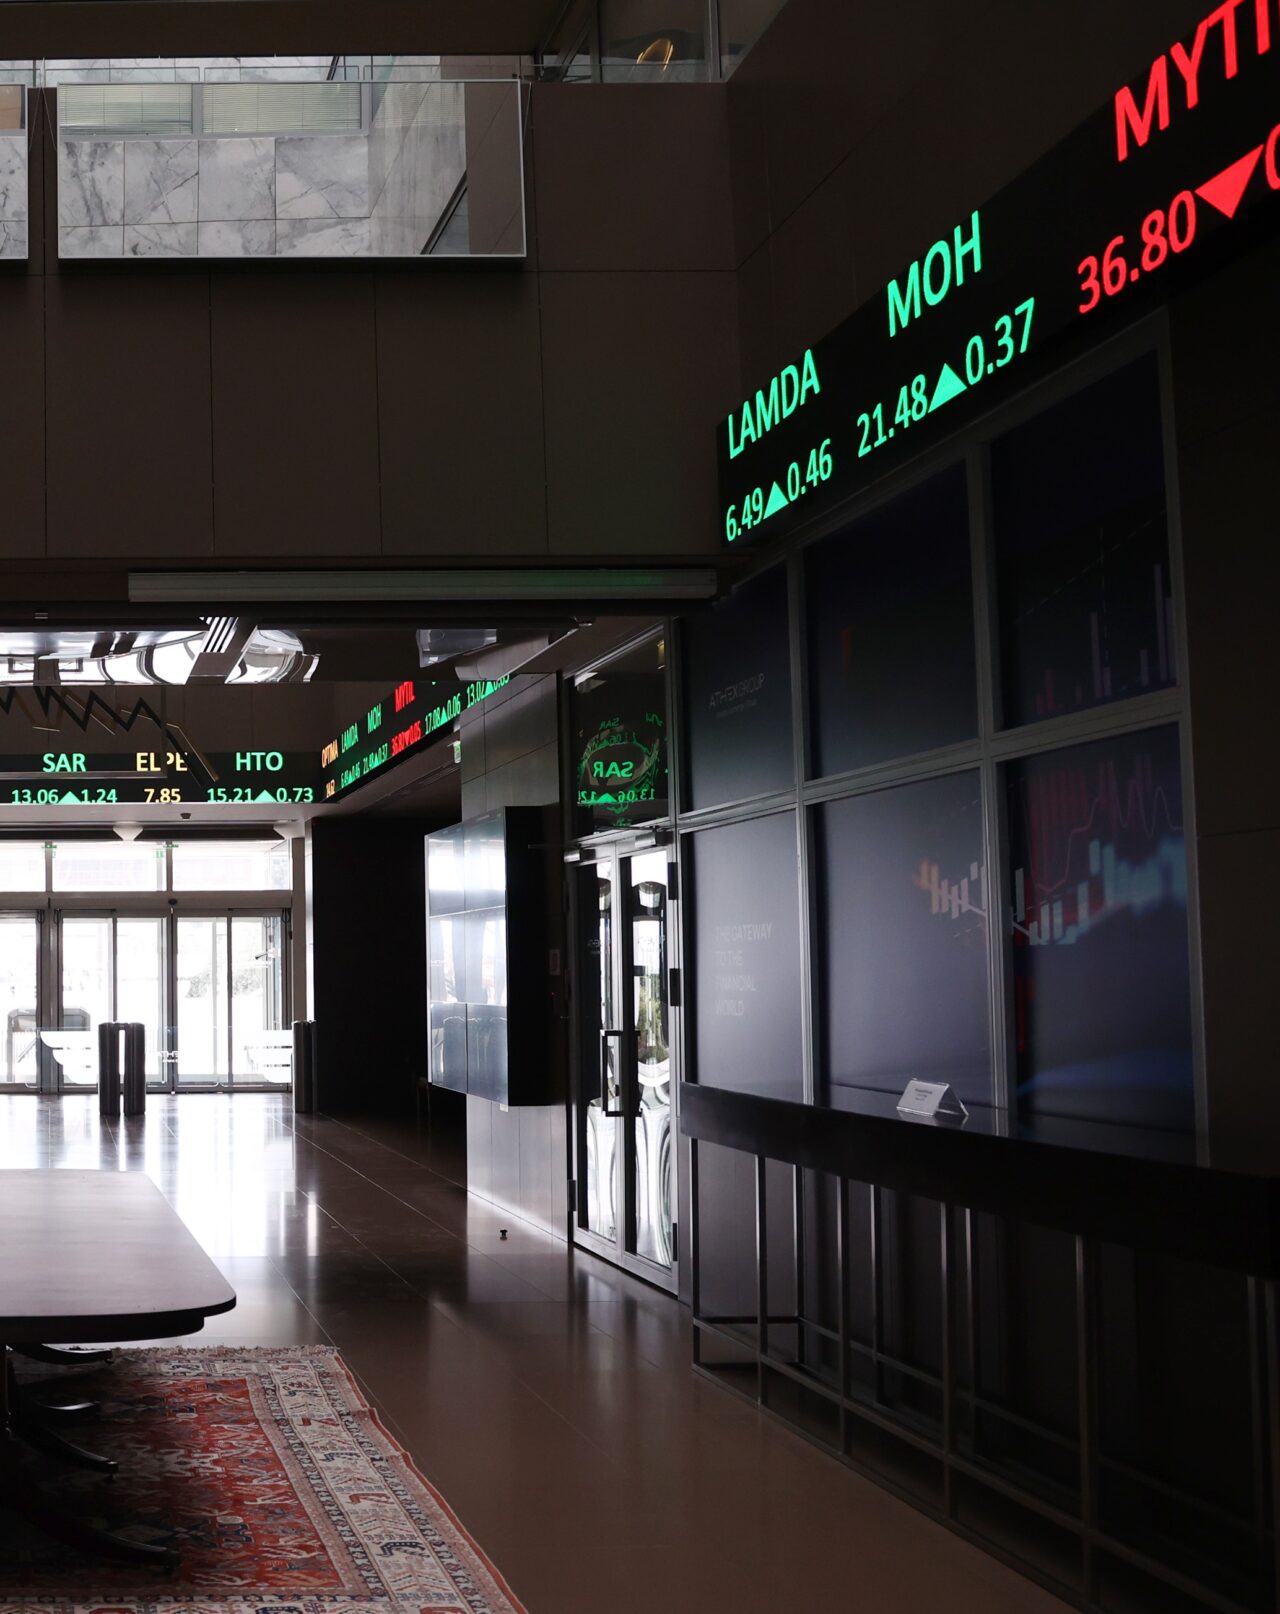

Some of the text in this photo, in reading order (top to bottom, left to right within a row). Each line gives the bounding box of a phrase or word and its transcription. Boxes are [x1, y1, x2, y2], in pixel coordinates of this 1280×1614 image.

[1115, 0, 1280, 161] MYTI
[1078, 190, 1196, 313] 36.80
[729, 211, 981, 459] LAMDA MOH
[727, 297, 1034, 541] 6.49 0.46 21.48 0.37
[43, 752, 87, 773] SAR
[236, 751, 284, 772] HTO
[341, 722, 359, 754] LAMDA
[367, 703, 381, 734] MOH
[12, 789, 59, 804] 13.06
[81, 789, 118, 803] 1.24
[144, 788, 181, 803] 7.85
[207, 788, 252, 803] 15.21
[276, 787, 314, 803] 0.73
